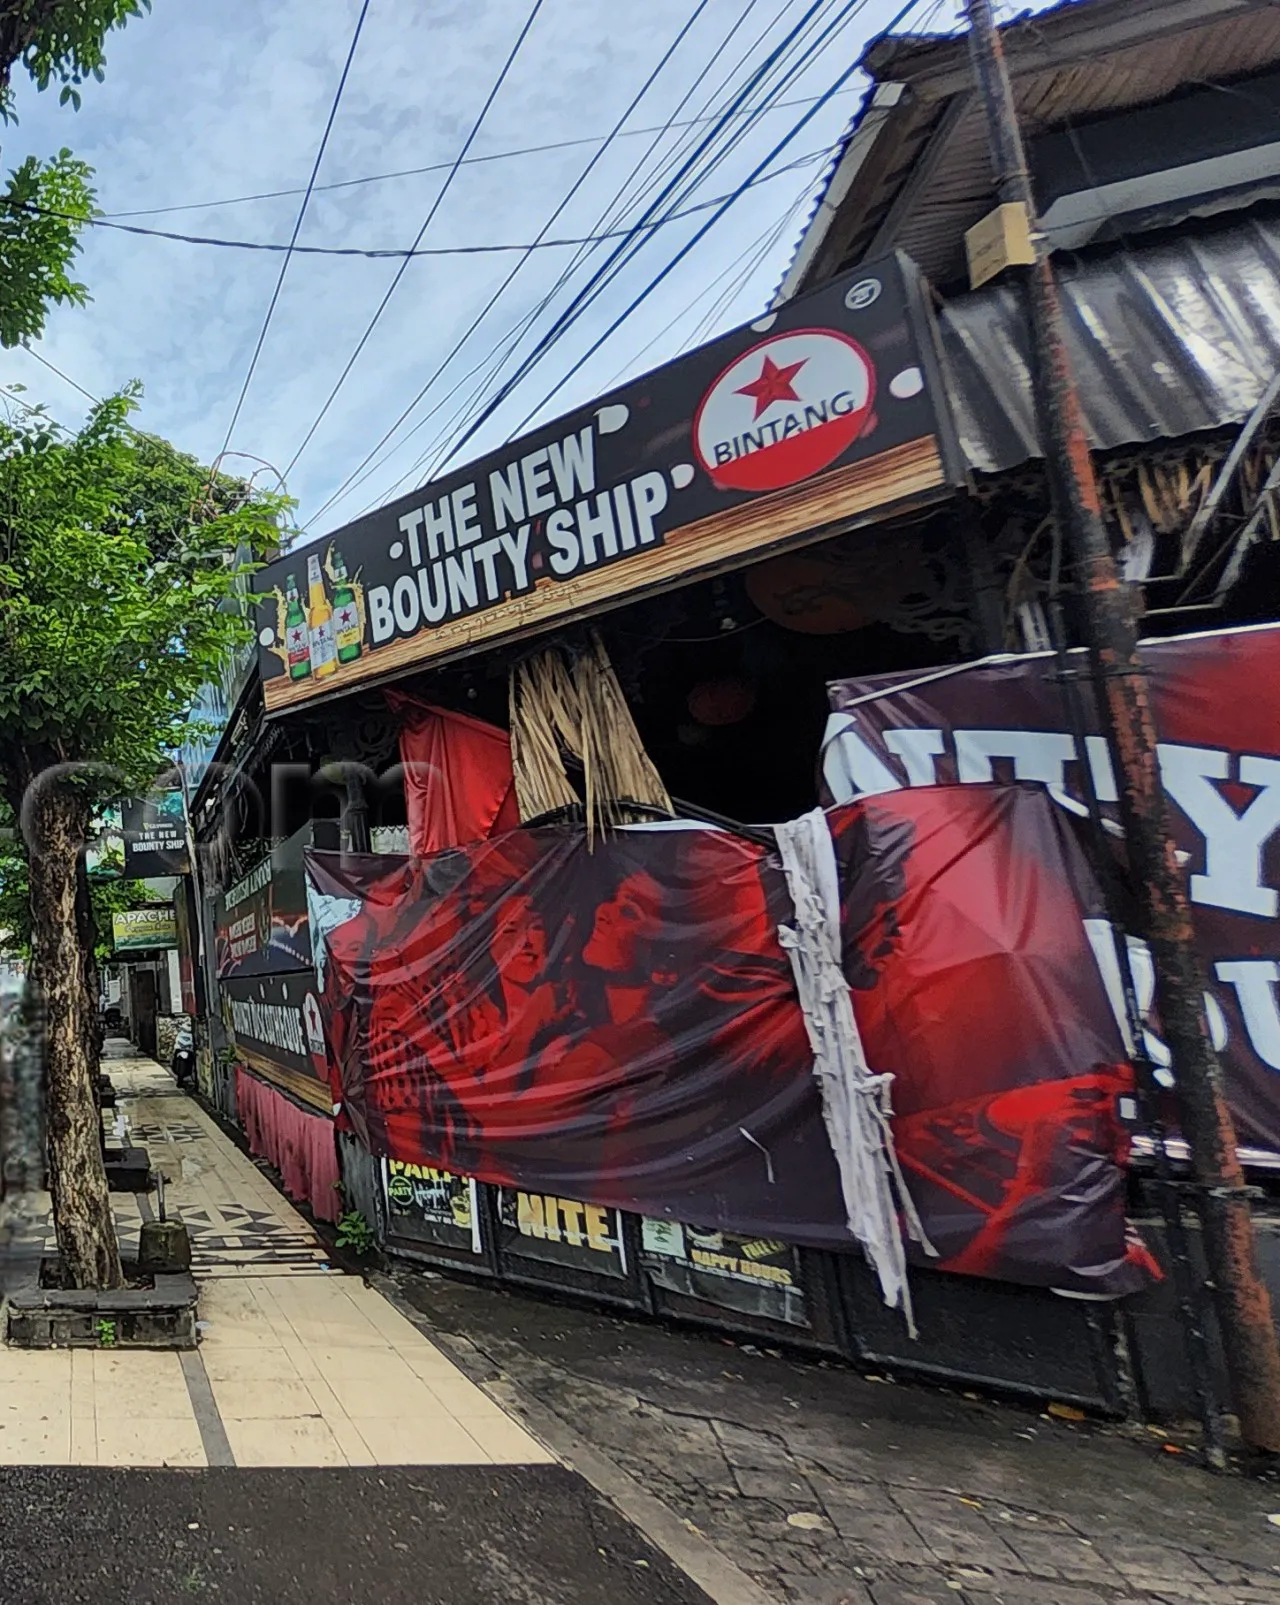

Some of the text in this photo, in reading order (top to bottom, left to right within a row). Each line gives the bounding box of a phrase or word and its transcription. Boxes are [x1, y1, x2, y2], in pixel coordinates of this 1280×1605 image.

[713, 390, 856, 466] BINTANG
[399, 425, 596, 568] THE NEW
[368, 522, 532, 644] BOUNTY
[546, 470, 669, 576] SHIP
[132, 840, 185, 852] BOUNTY SHIP
[115, 909, 176, 925] APACHE
[517, 1192, 612, 1252] NITE
